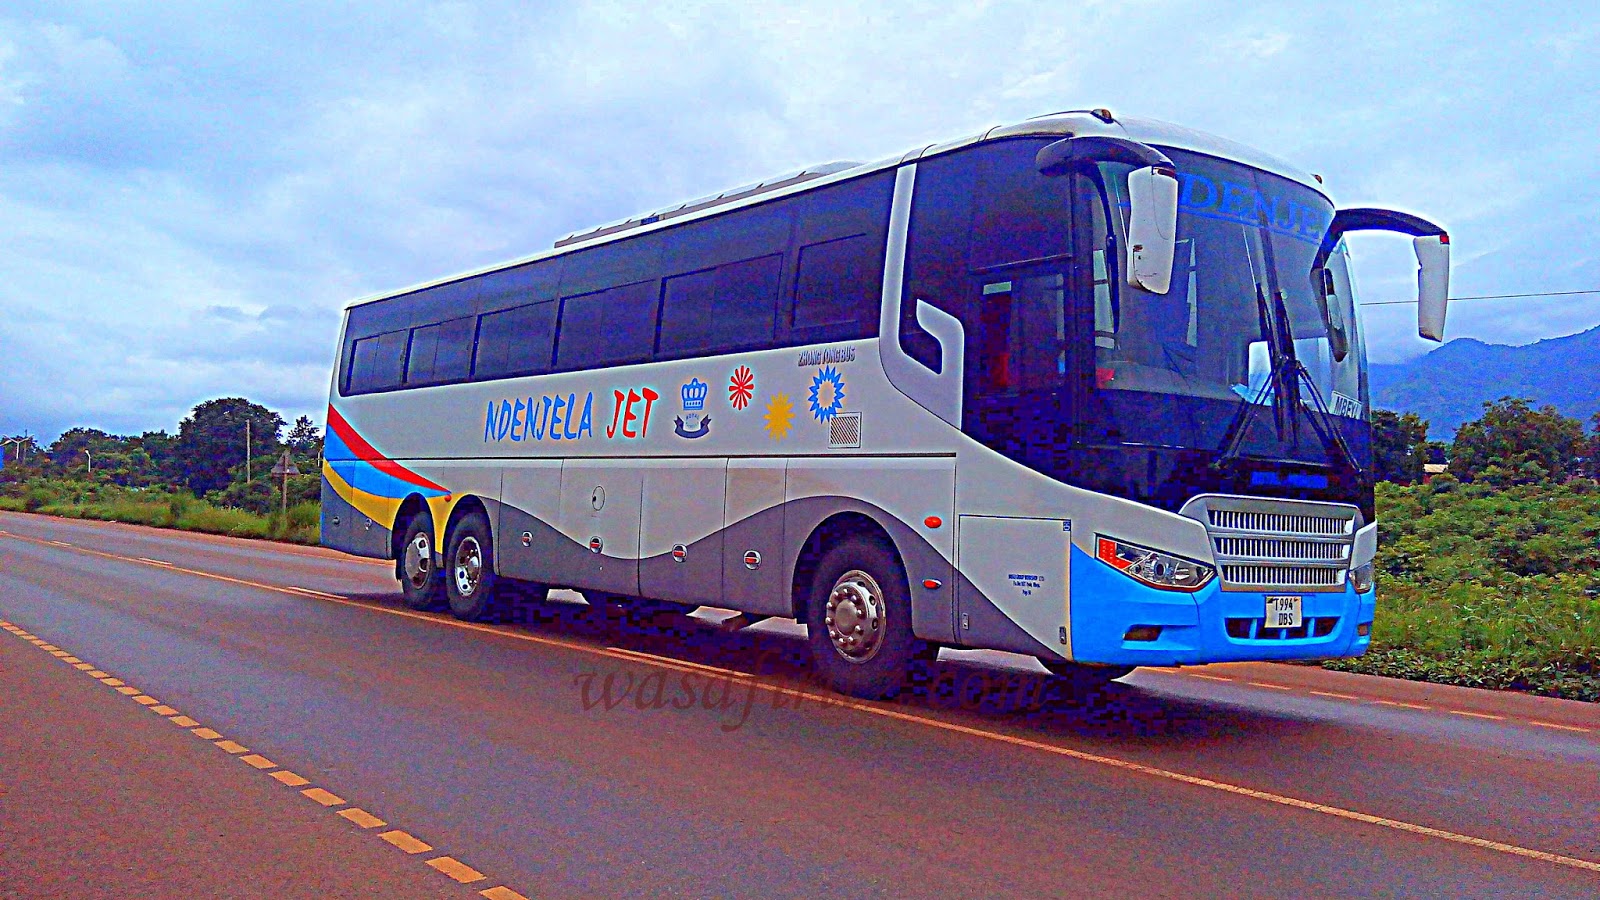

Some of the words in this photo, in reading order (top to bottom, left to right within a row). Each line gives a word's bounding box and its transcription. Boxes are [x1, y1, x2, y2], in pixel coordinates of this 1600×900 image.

[1177, 172, 1322, 240] DENJE
[485, 391, 593, 443] NDENJELA
[606, 387, 659, 439] JET
[1274, 597, 1294, 611] T994
[1278, 612, 1294, 626] DBS
